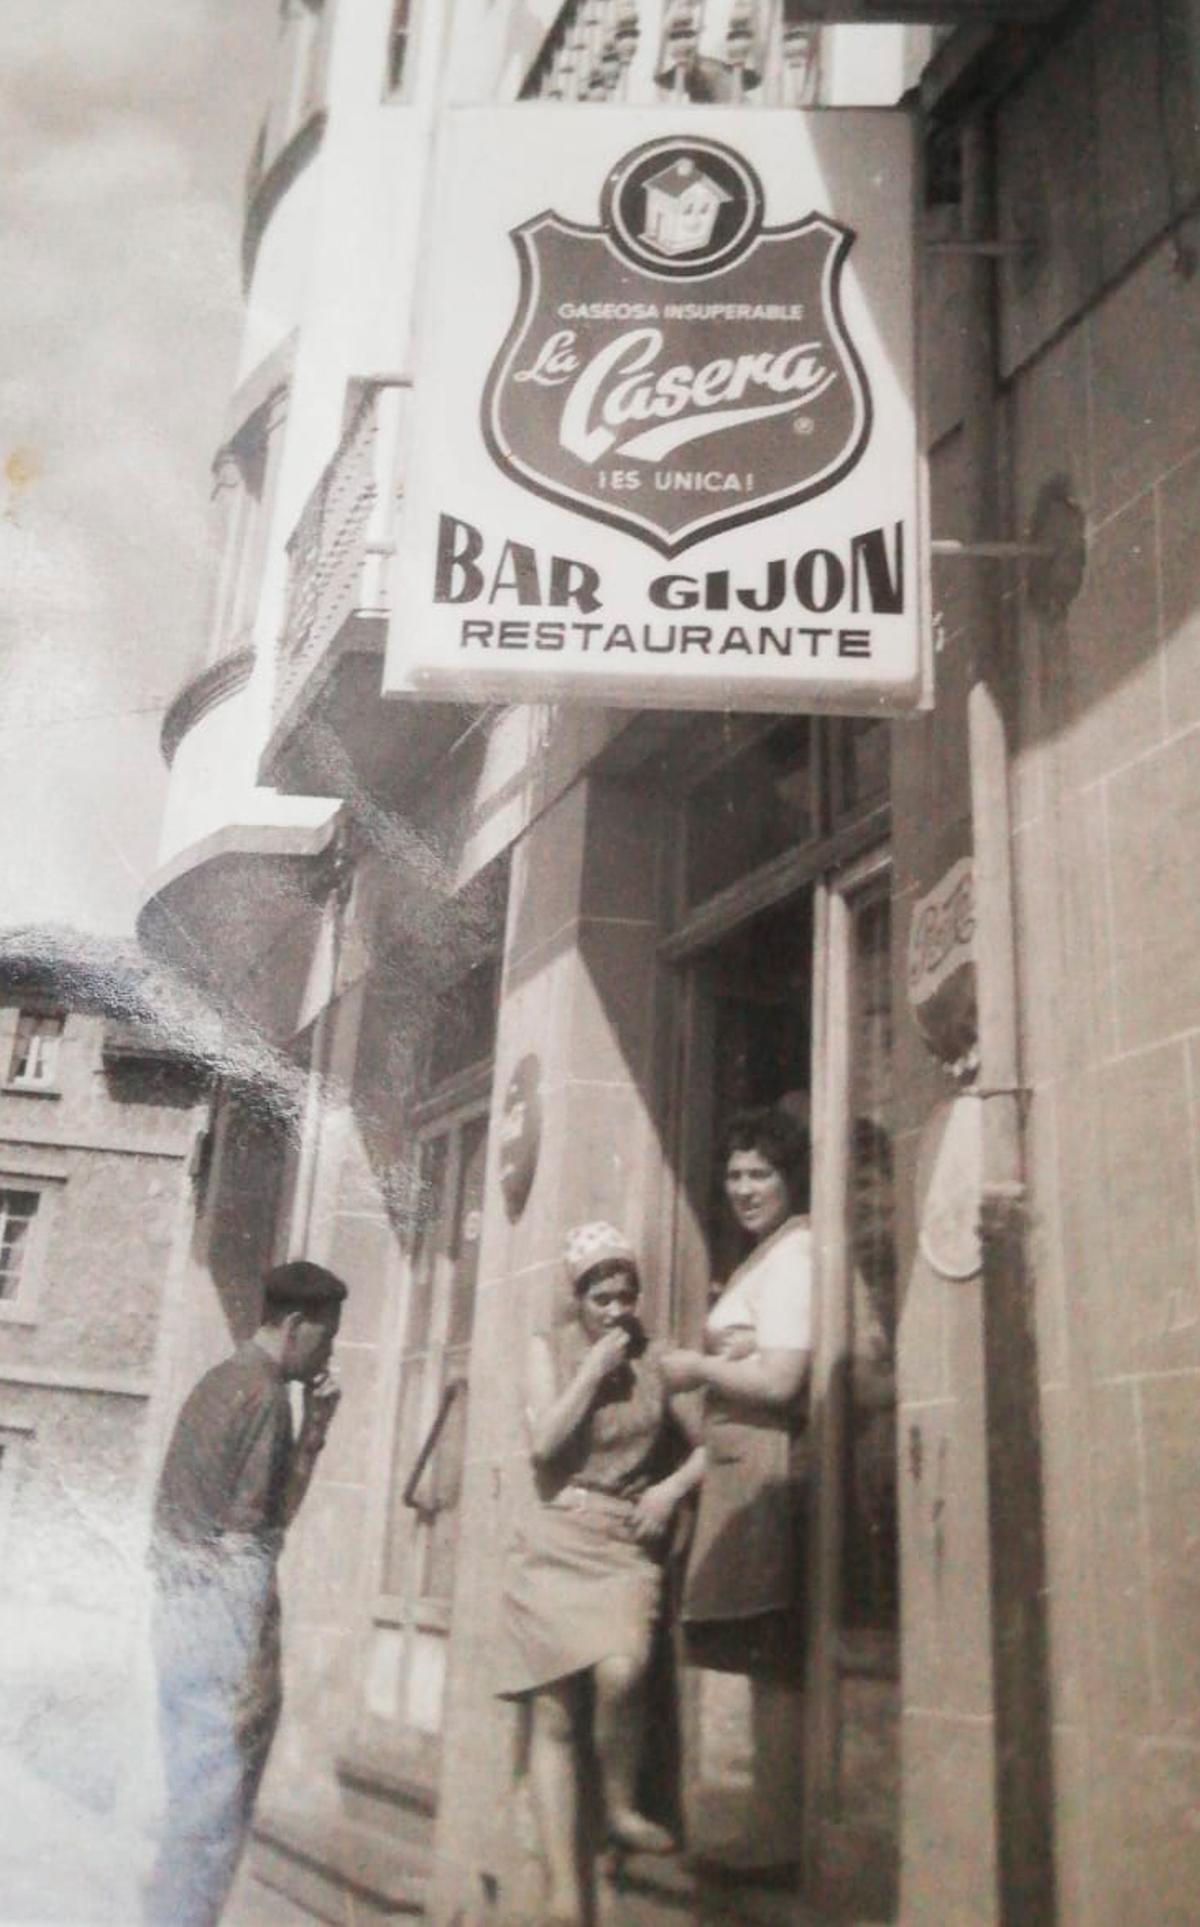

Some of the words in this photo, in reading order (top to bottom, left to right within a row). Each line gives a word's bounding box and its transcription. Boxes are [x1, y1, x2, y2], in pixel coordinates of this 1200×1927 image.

[558, 303, 658, 320] GASEOSA
[663, 303, 805, 321] INSUPERABLE
[513, 329, 579, 386] La
[558, 327, 837, 464] Casera
[655, 471, 754, 491] UNICA!
[433, 512, 604, 615] BAR
[648, 520, 905, 616] GIJON
[459, 619, 873, 658] RESTAURANTE
